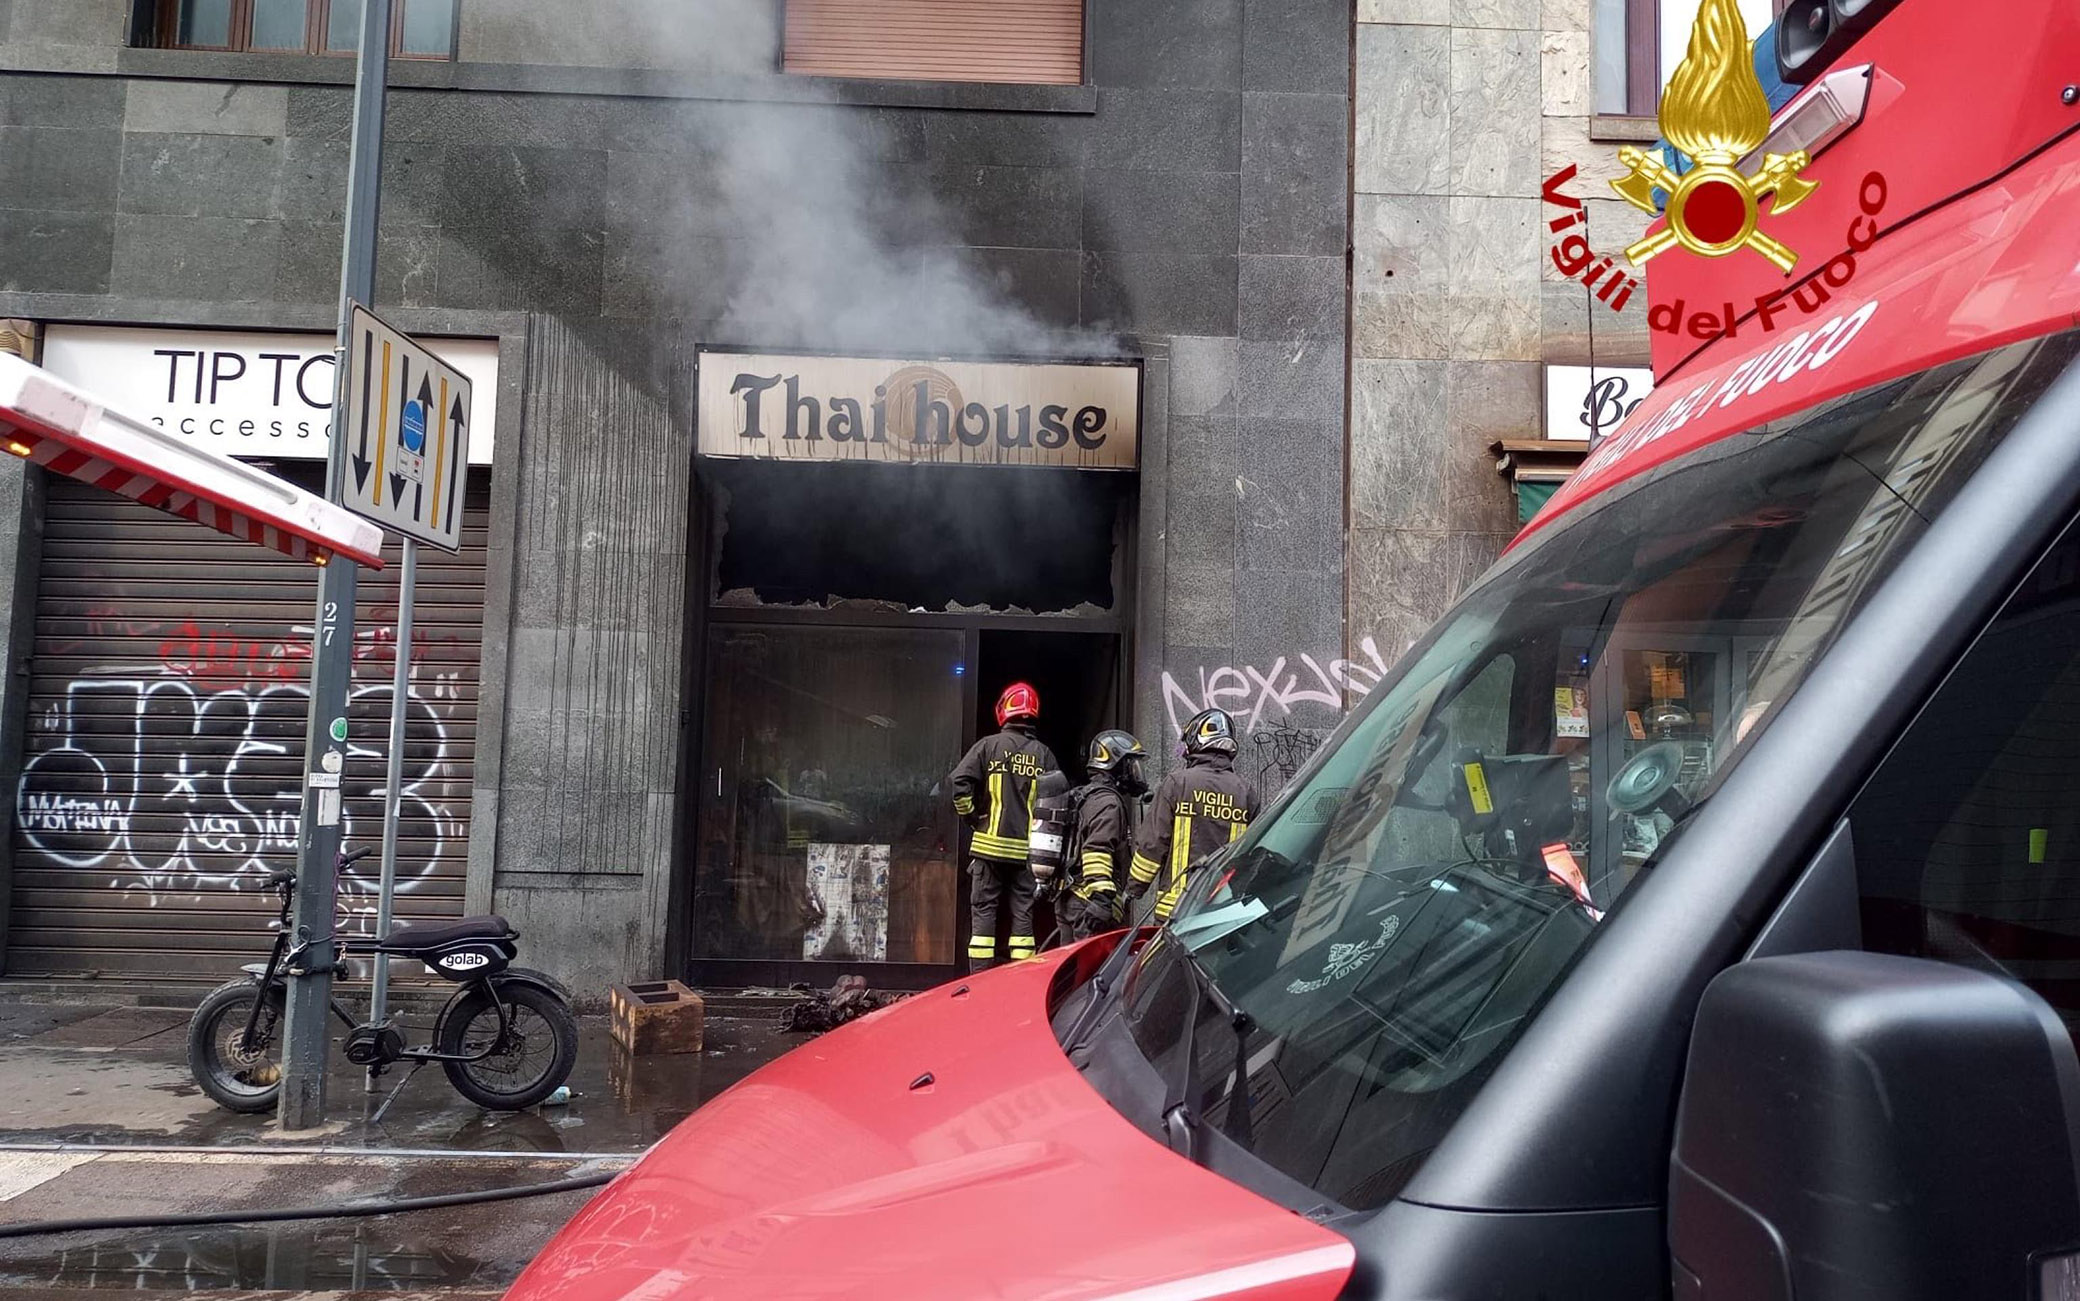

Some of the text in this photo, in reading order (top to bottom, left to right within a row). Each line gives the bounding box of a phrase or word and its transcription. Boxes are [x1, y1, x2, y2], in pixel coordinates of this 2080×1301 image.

[153, 349, 247, 405] TIP
[1633, 377, 1719, 453] DEL
[1694, 299, 1880, 421] FUOCO
[729, 372, 1108, 450] Thai house
[1012, 763, 1046, 778] FUOC
[1193, 789, 1234, 808] VIGILI
[446, 952, 484, 967] golab
